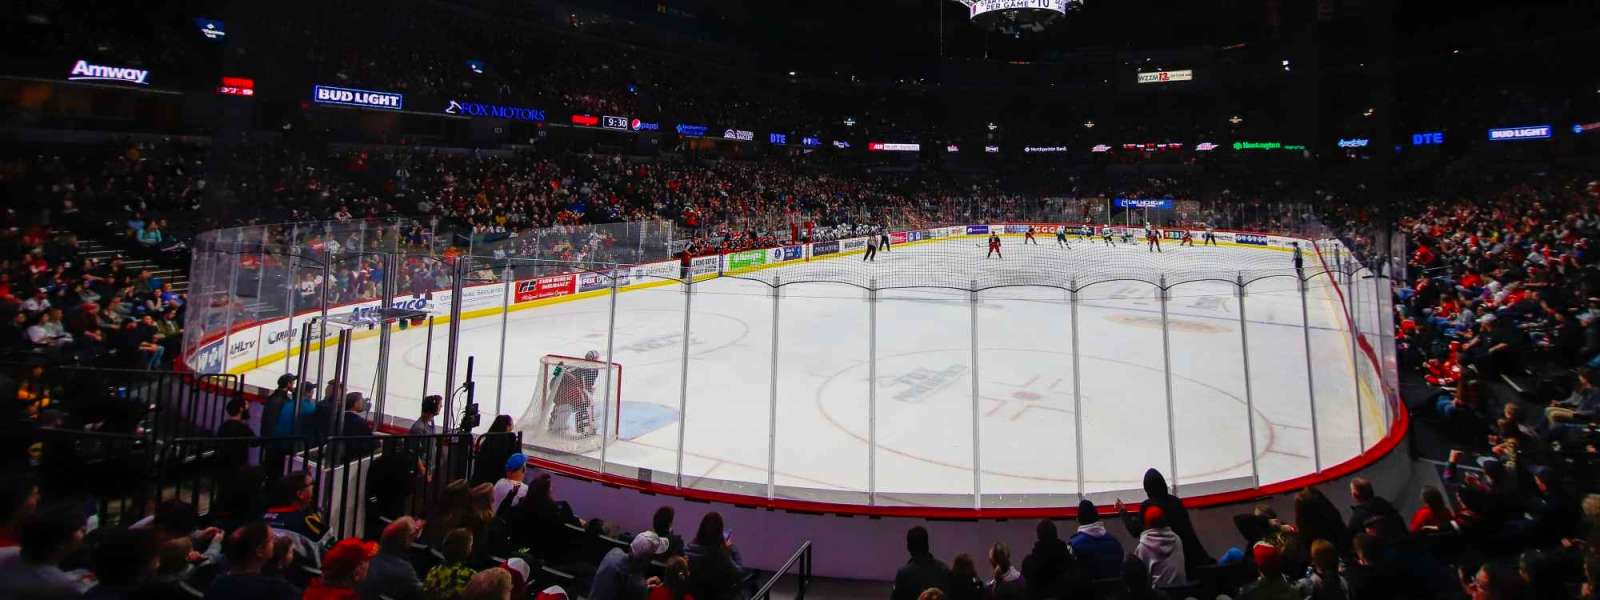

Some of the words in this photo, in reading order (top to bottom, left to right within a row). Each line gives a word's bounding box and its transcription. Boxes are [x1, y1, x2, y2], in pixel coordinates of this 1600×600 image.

[71, 59, 148, 84] Amway
[318, 87, 353, 102] BUD
[354, 92, 400, 107] LIGHT
[461, 101, 490, 117] FOX
[491, 104, 545, 121] MOTORS
[608, 117, 626, 128] 9:30
[770, 133, 786, 145] DTE
[1412, 132, 1444, 146] DTE
[1491, 129, 1514, 139] BUD
[1514, 127, 1550, 138] LIGHT
[352, 298, 428, 321] ATHTICO
